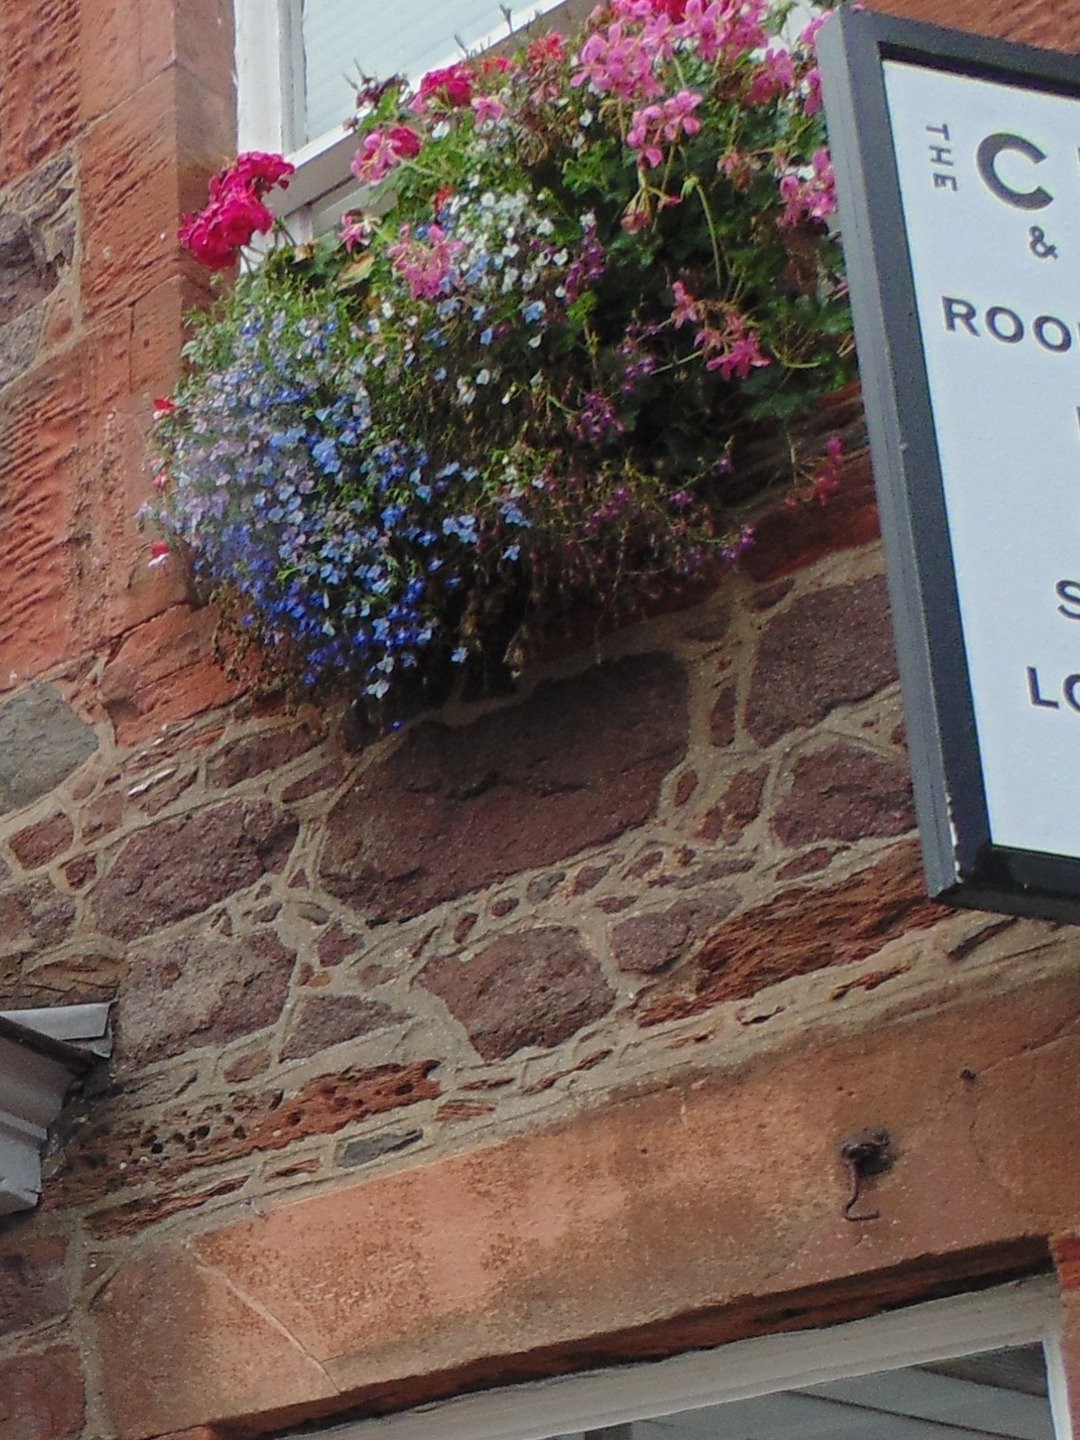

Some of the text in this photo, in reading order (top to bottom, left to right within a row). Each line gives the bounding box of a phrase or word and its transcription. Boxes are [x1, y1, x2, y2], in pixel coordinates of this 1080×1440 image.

[926, 123, 1080, 212] THE C
[1028, 225, 1059, 260] &
[941, 295, 1080, 354] ROO
